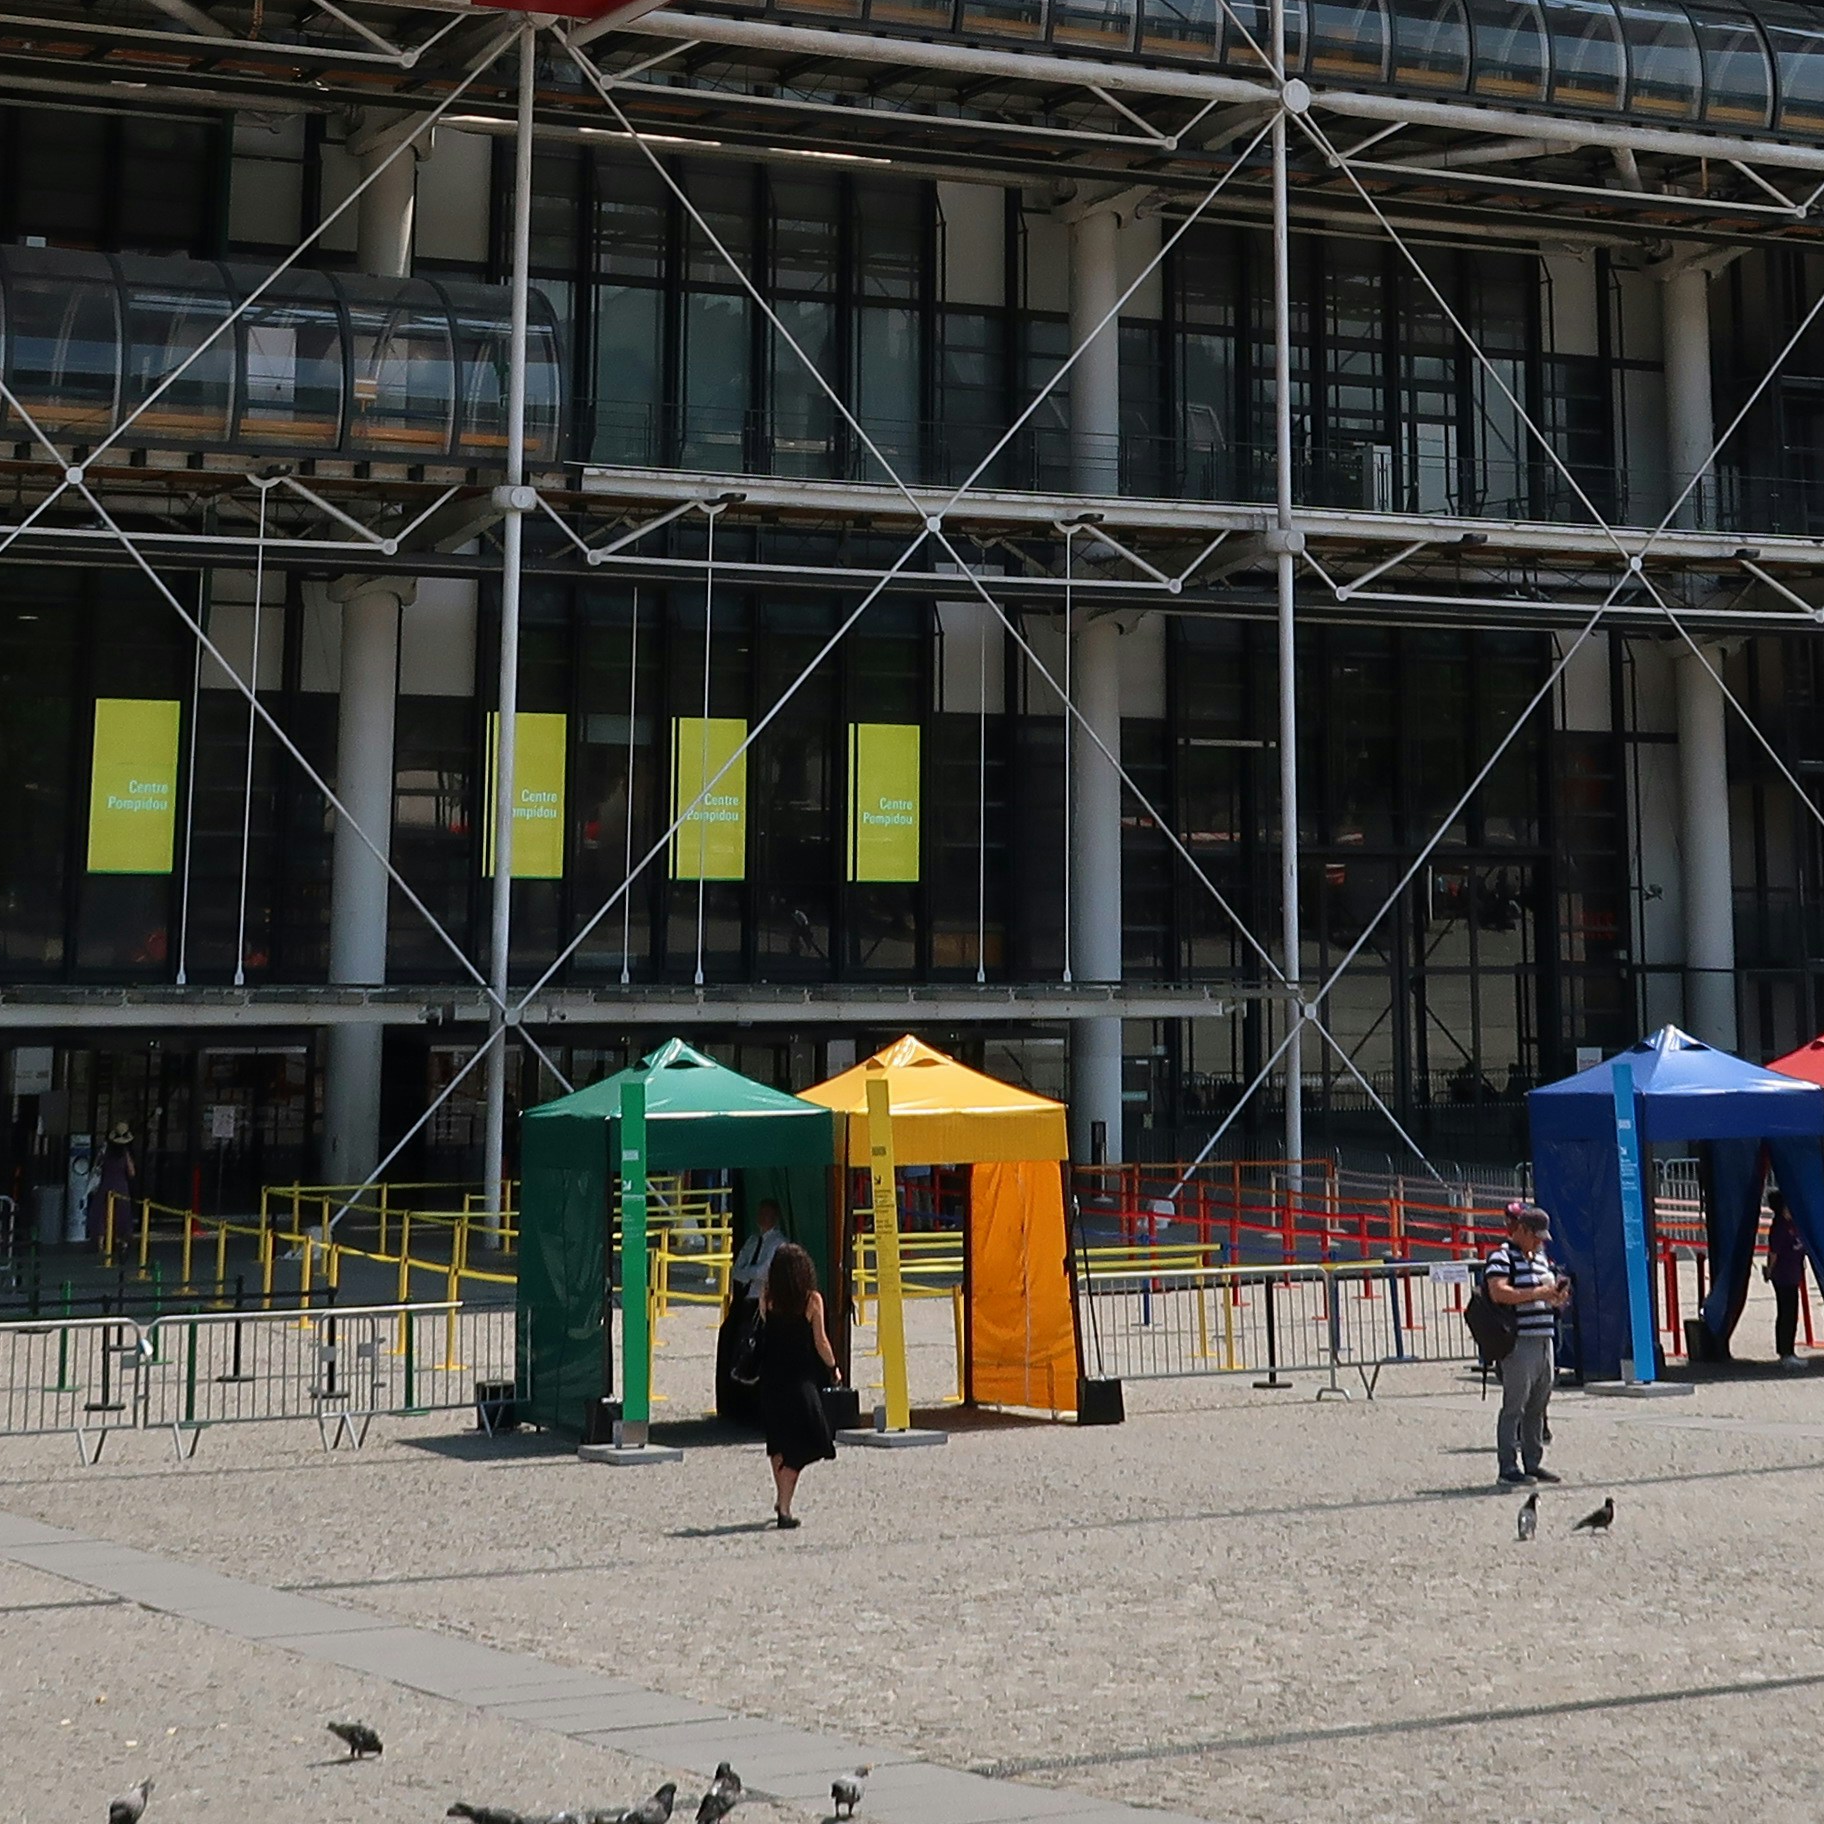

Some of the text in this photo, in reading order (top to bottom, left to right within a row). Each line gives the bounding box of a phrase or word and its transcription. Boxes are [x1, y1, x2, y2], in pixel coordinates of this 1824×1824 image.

[129, 779, 168, 794] Centre
[521, 788, 558, 803] Centre
[704, 792, 739, 806] Centre
[107, 796, 168, 812] Pompidou
[879, 797, 913, 810] Centre
[512, 805, 557, 820] ompidou
[686, 809, 739, 823] Pompidou
[863, 812, 913, 828] Pompidou
